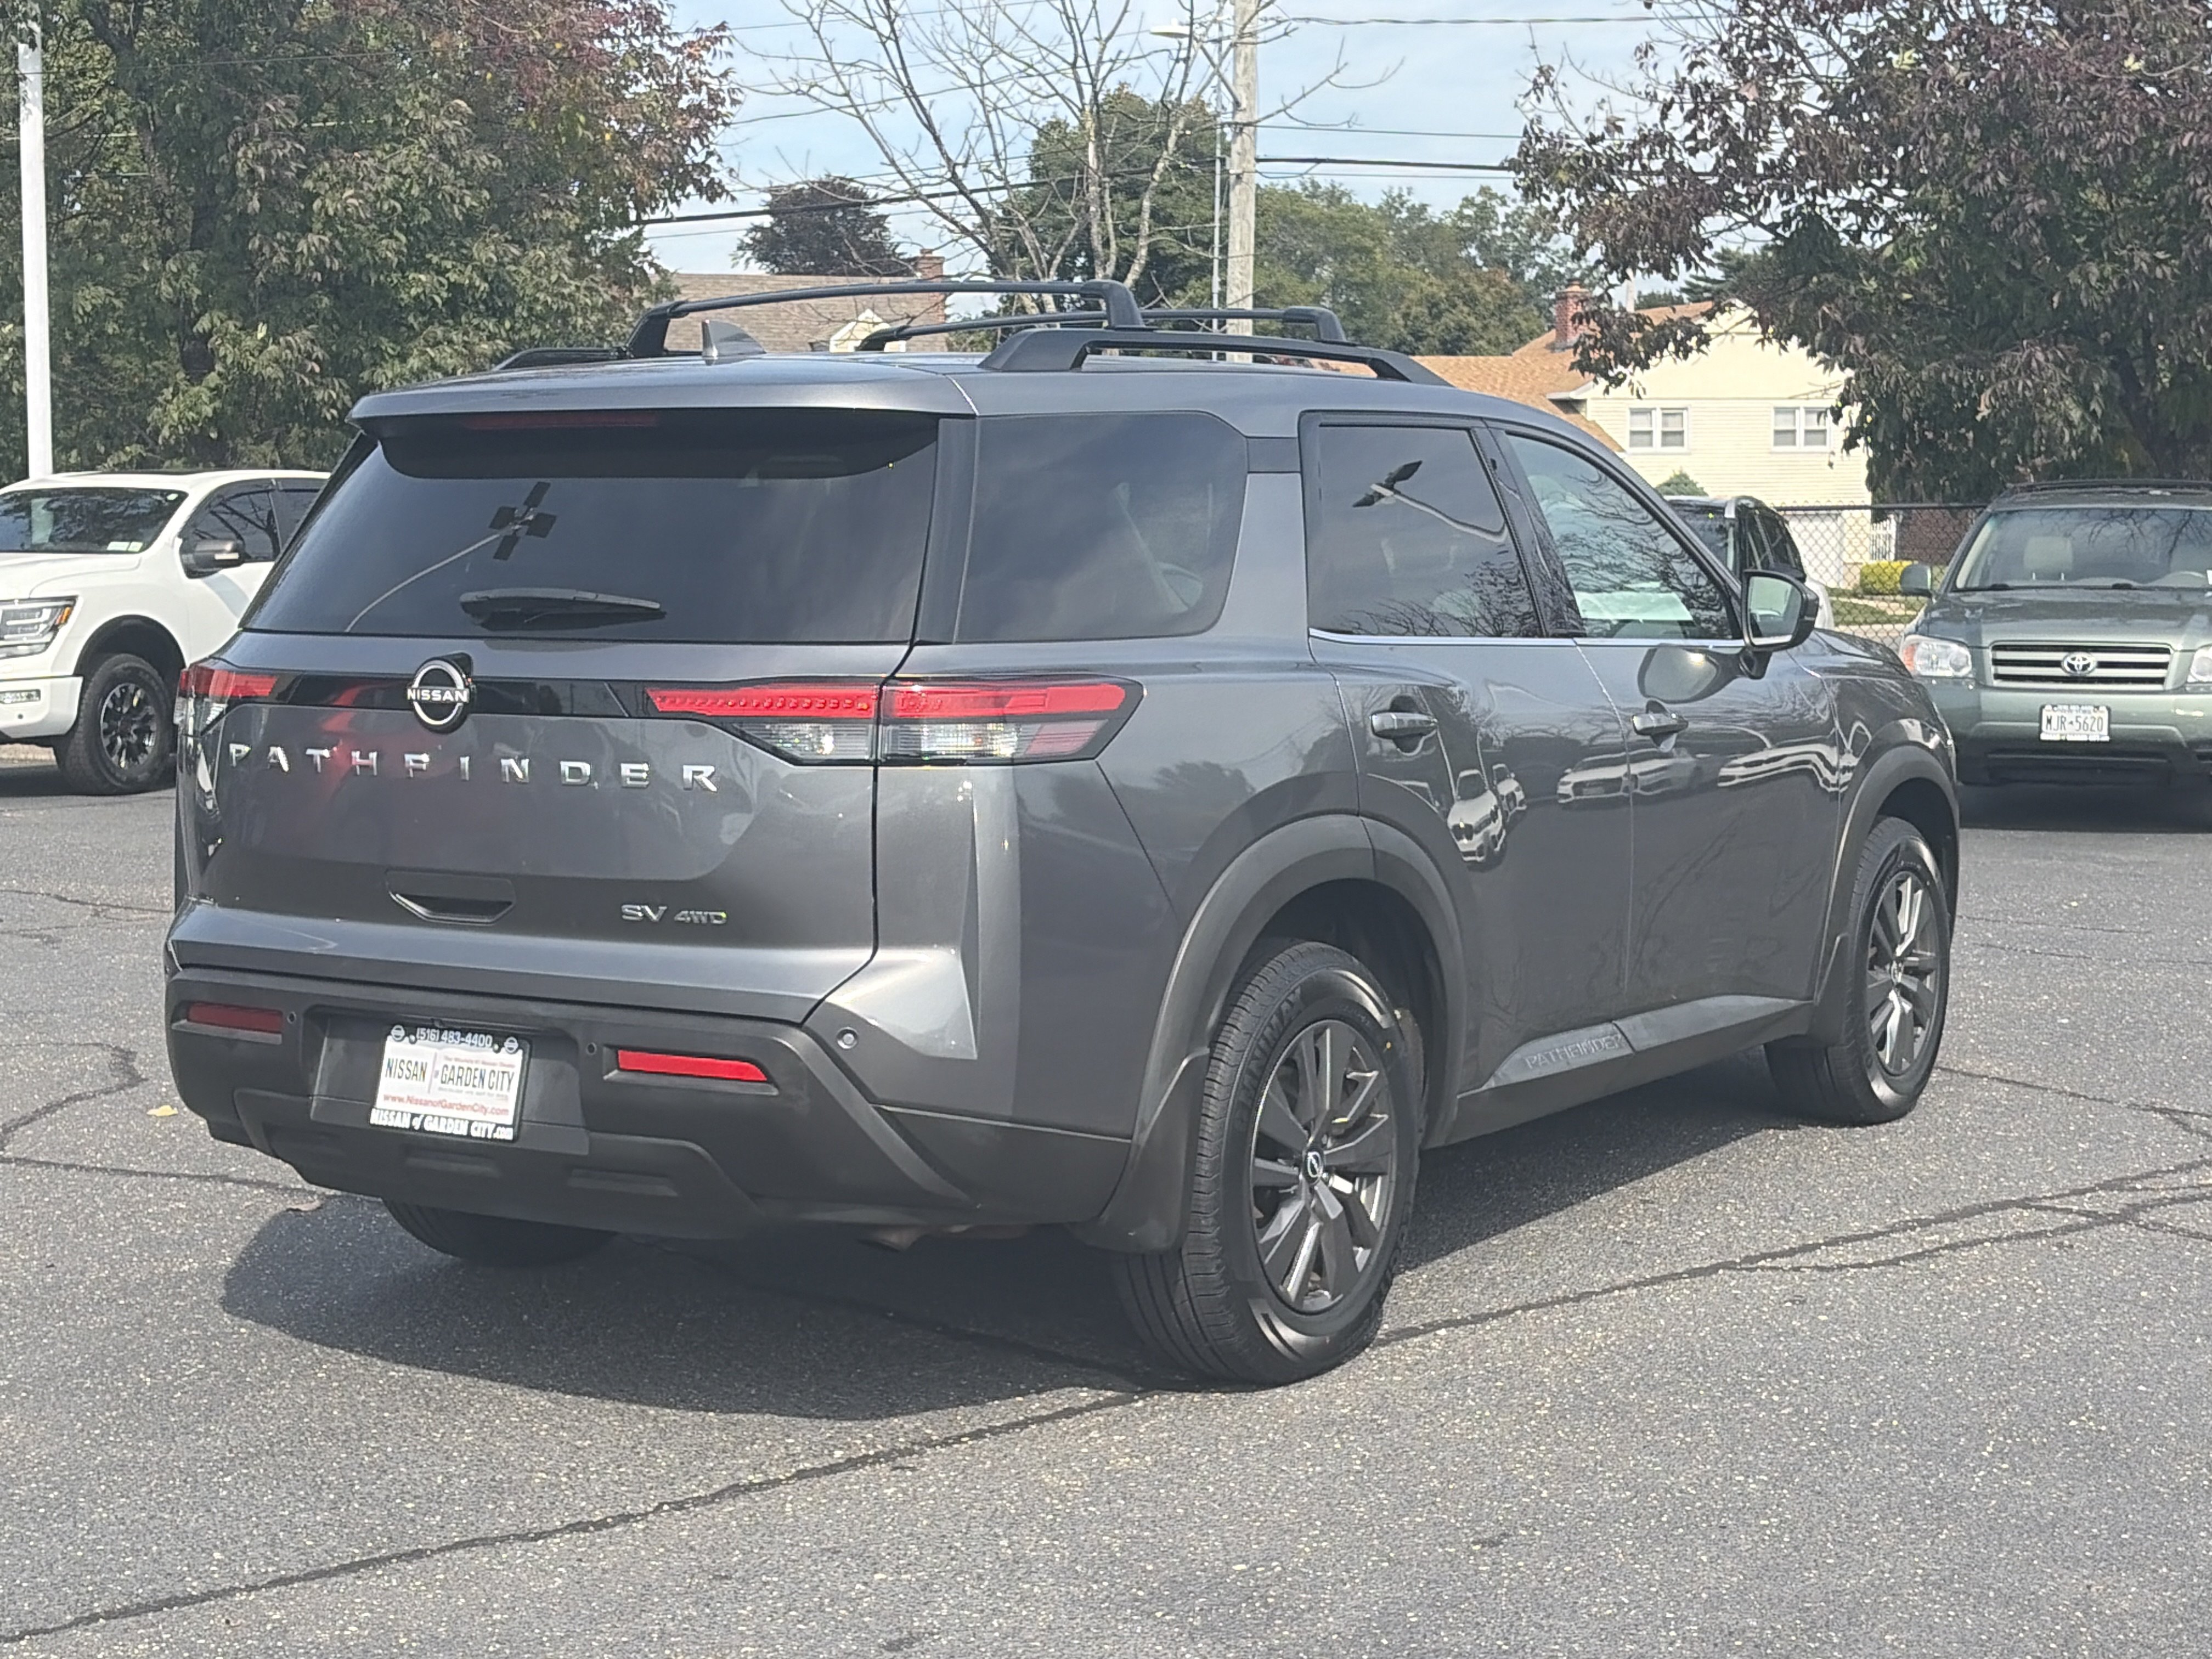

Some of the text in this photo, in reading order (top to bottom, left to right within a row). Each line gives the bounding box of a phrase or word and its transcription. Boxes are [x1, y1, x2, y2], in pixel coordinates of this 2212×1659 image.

[407, 688, 468, 703] NISSAN
[228, 743, 718, 793] PATHFINDER
[621, 904, 727, 925] SV 4WD
[416, 1027, 493, 1047] (516) 483-4400
[1525, 1034, 1624, 1070] PATHFINDER
[385, 1058, 427, 1082] NISSAN
[441, 1064, 486, 1089] GARDEN
[488, 1070, 515, 1092] CITY
[383, 1093, 509, 1116] www.NissanofGardenCity.com
[370, 1108, 411, 1128] NISSAN
[424, 1116, 469, 1136] GARDEN
